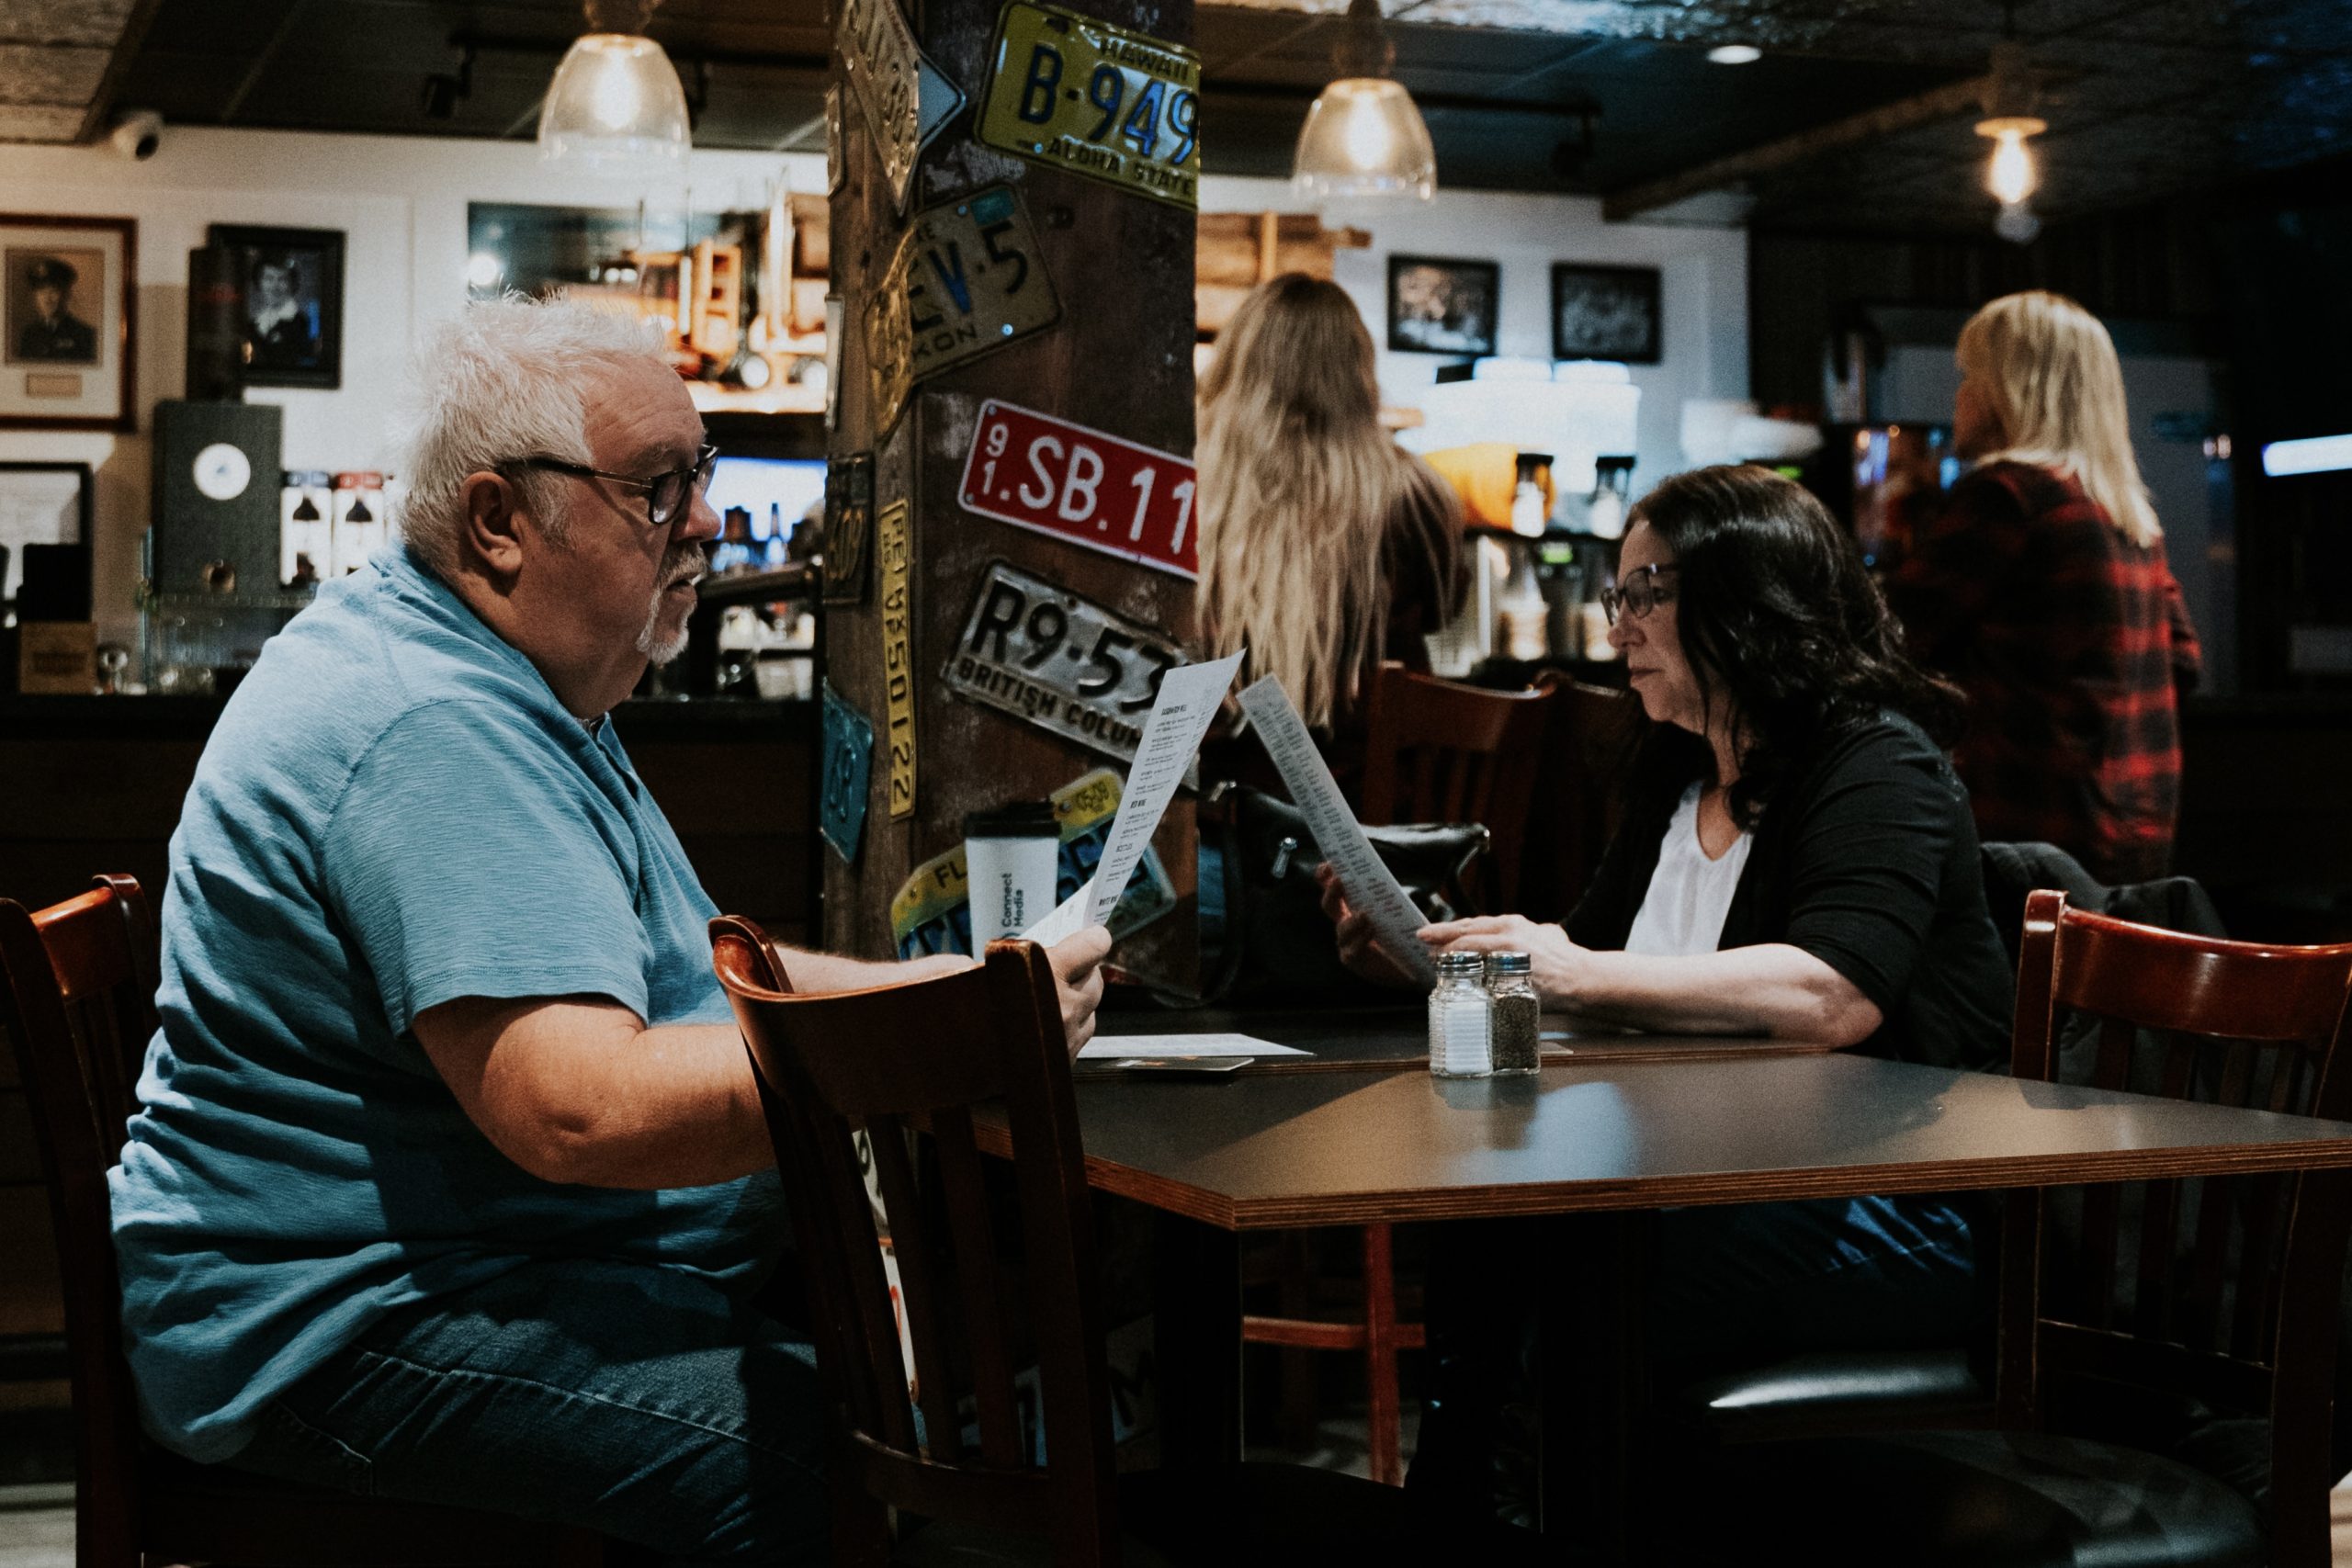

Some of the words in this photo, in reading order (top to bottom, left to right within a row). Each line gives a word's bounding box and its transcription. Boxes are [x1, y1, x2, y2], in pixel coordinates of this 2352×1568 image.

[1101, 36, 1189, 81] HAWAII
[1047, 137, 1121, 175] ALOHA
[1134, 163, 1195, 194] STATE
[958, 656, 1058, 718] BRITISH
[1001, 873, 1012, 928] Connect
[1013, 889, 1024, 928] Media
